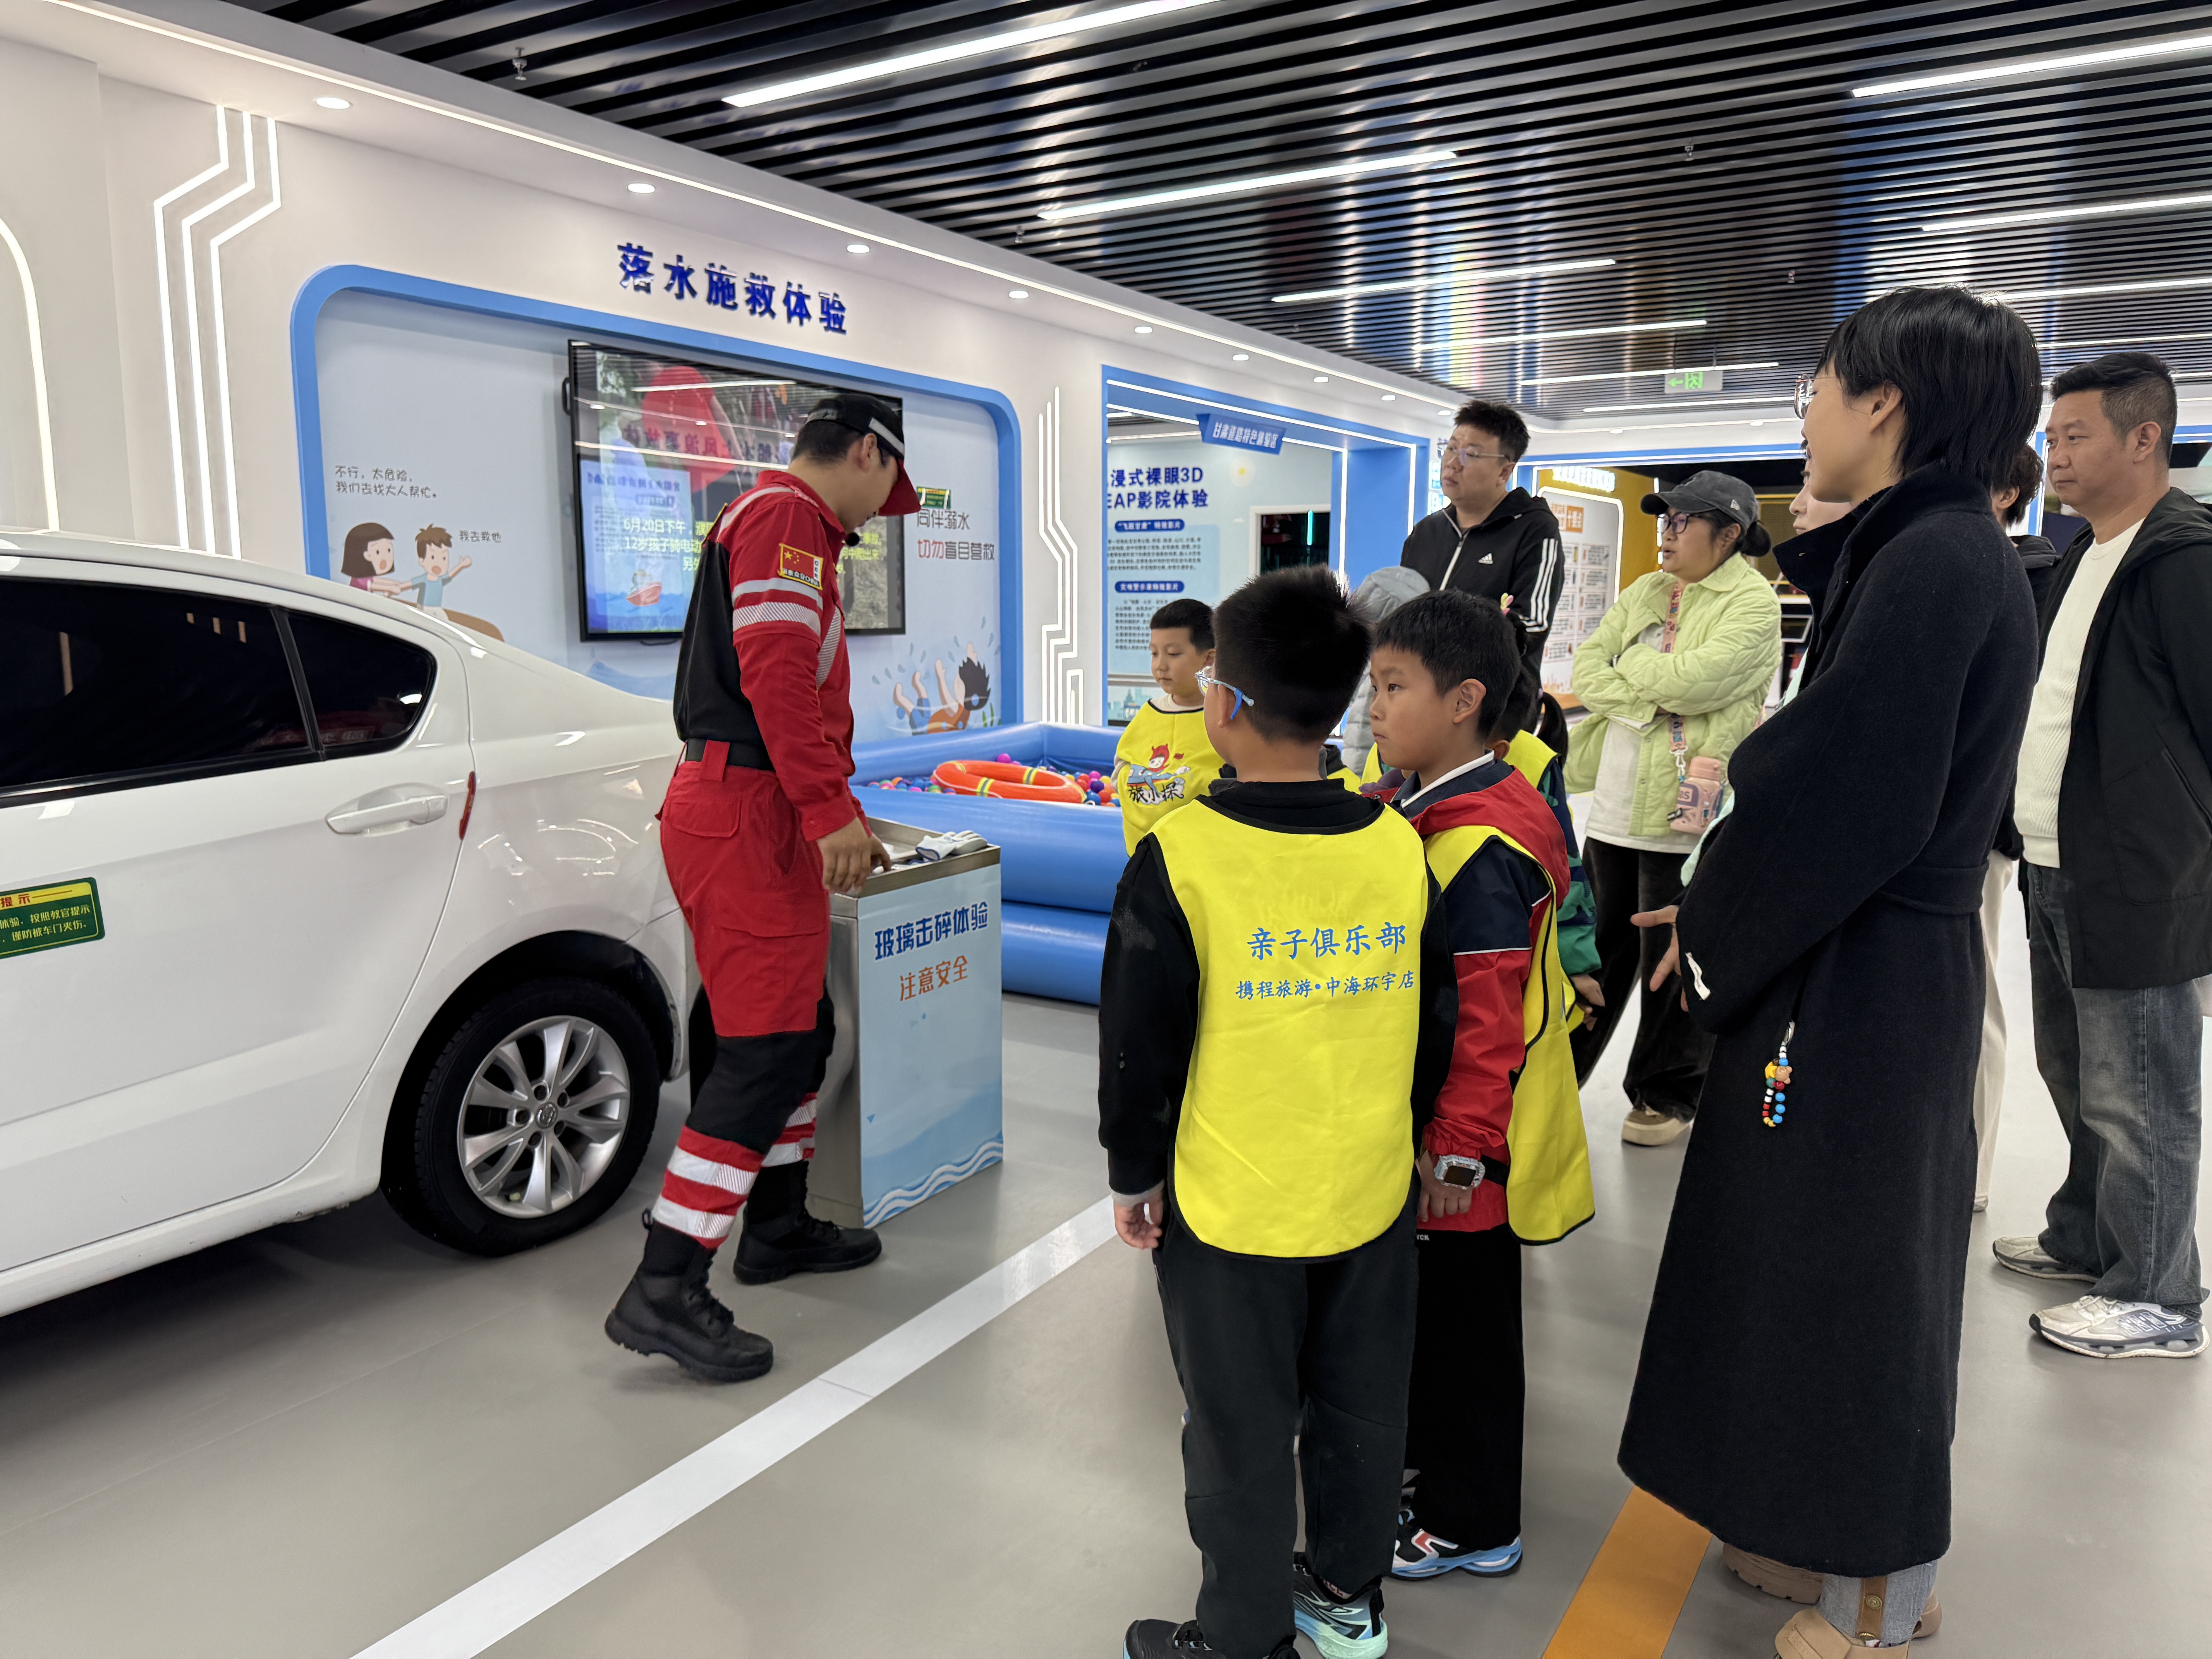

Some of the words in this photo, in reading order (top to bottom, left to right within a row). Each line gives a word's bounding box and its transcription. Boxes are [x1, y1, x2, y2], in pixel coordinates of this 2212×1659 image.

[617, 242, 847, 335] 落水施救体验
[1111, 467, 1203, 487] 浸式裸眼3D
[874, 901, 989, 961] 玻璃击碎体验
[1247, 921, 1406, 960] 亲子俱乐部
[900, 955, 969, 1001] 注意安全
